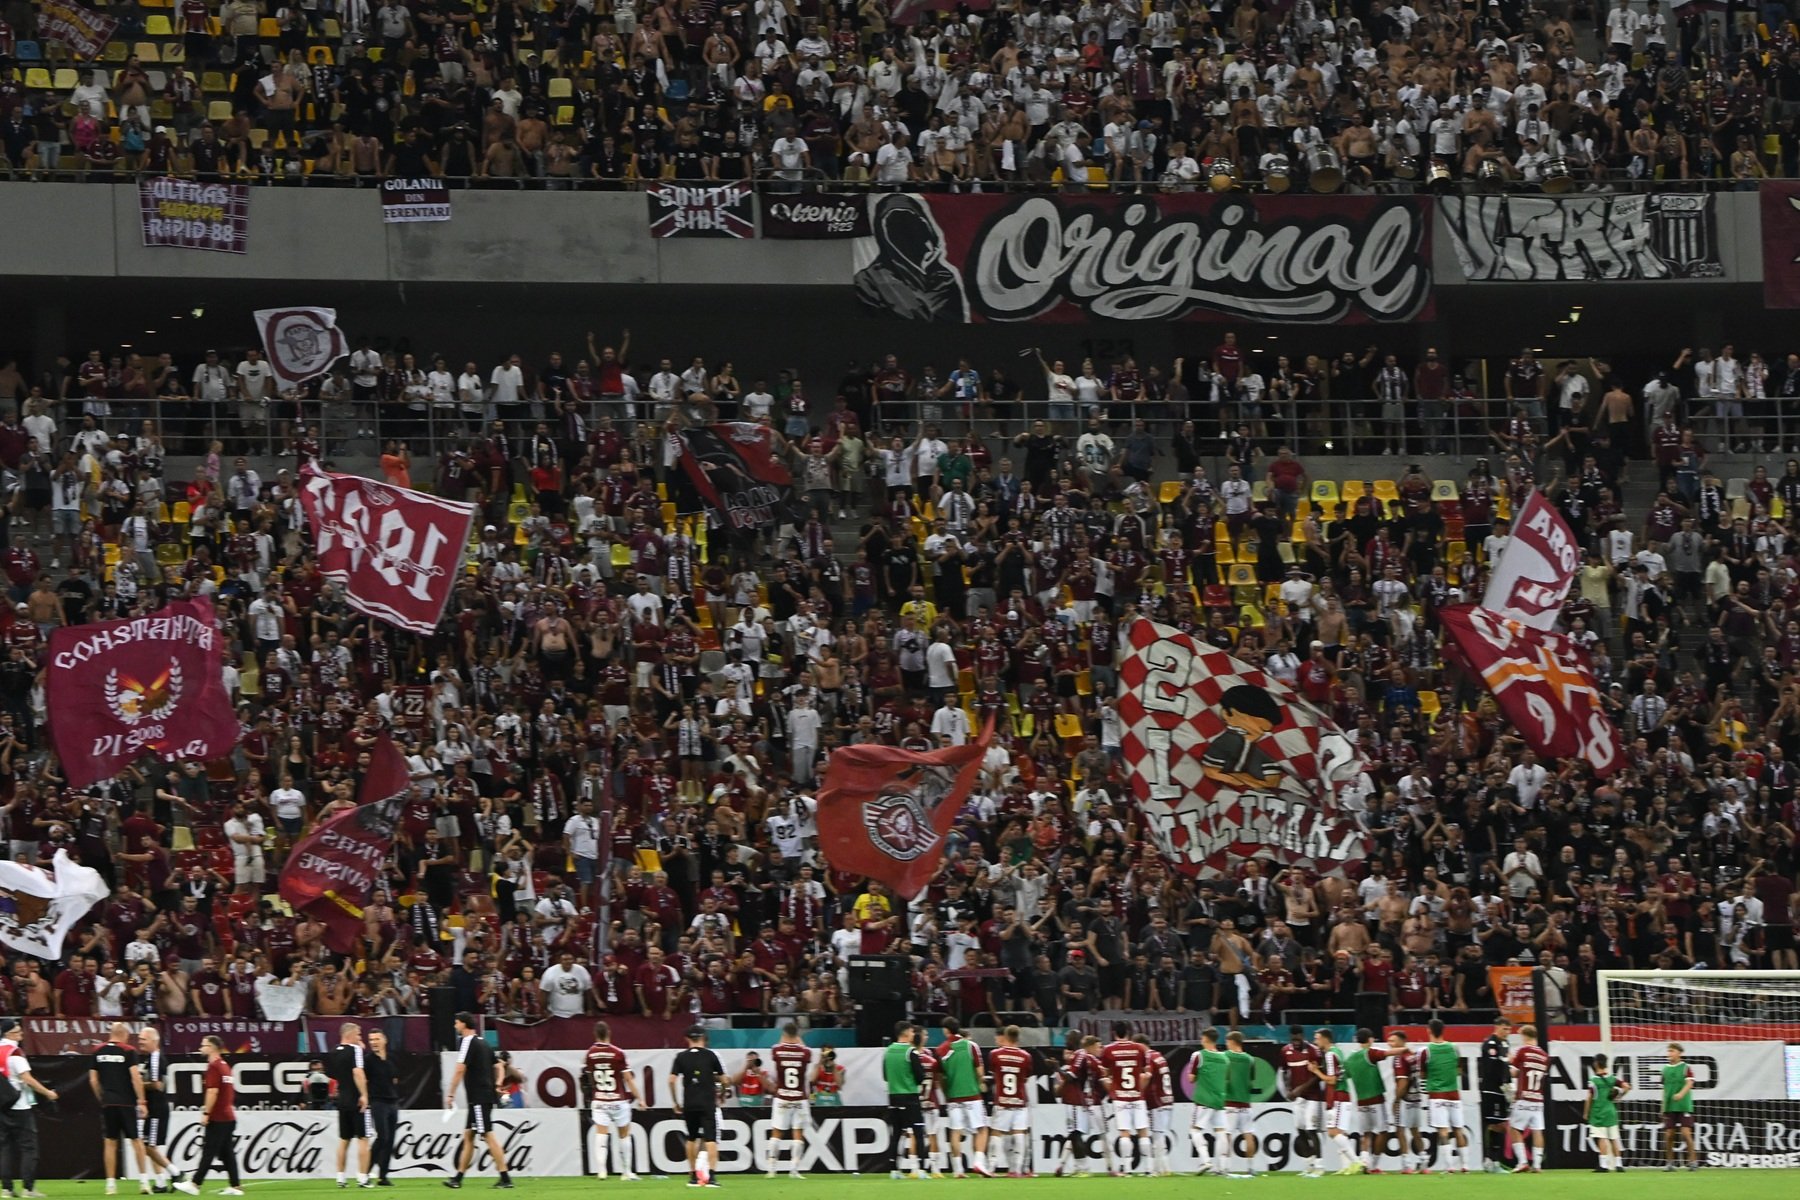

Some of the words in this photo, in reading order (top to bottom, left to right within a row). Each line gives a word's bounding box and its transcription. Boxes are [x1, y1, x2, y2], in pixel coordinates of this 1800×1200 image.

[154, 181, 228, 204] ULTRAS
[659, 187, 740, 207] SOUTH
[384, 206, 449, 218] FERENTARI
[674, 209, 729, 230] SIDE
[211, 223, 234, 242] 88
[827, 221, 854, 232] 1923
[976, 196, 1420, 320] Original
[128, 724, 165, 741] 2008
[29, 1019, 84, 1034] ALBA
[593, 1069, 617, 1091] 95
[784, 1067, 800, 1089] 6
[1002, 1073, 1018, 1096] 9
[1120, 1067, 1136, 1089] 5
